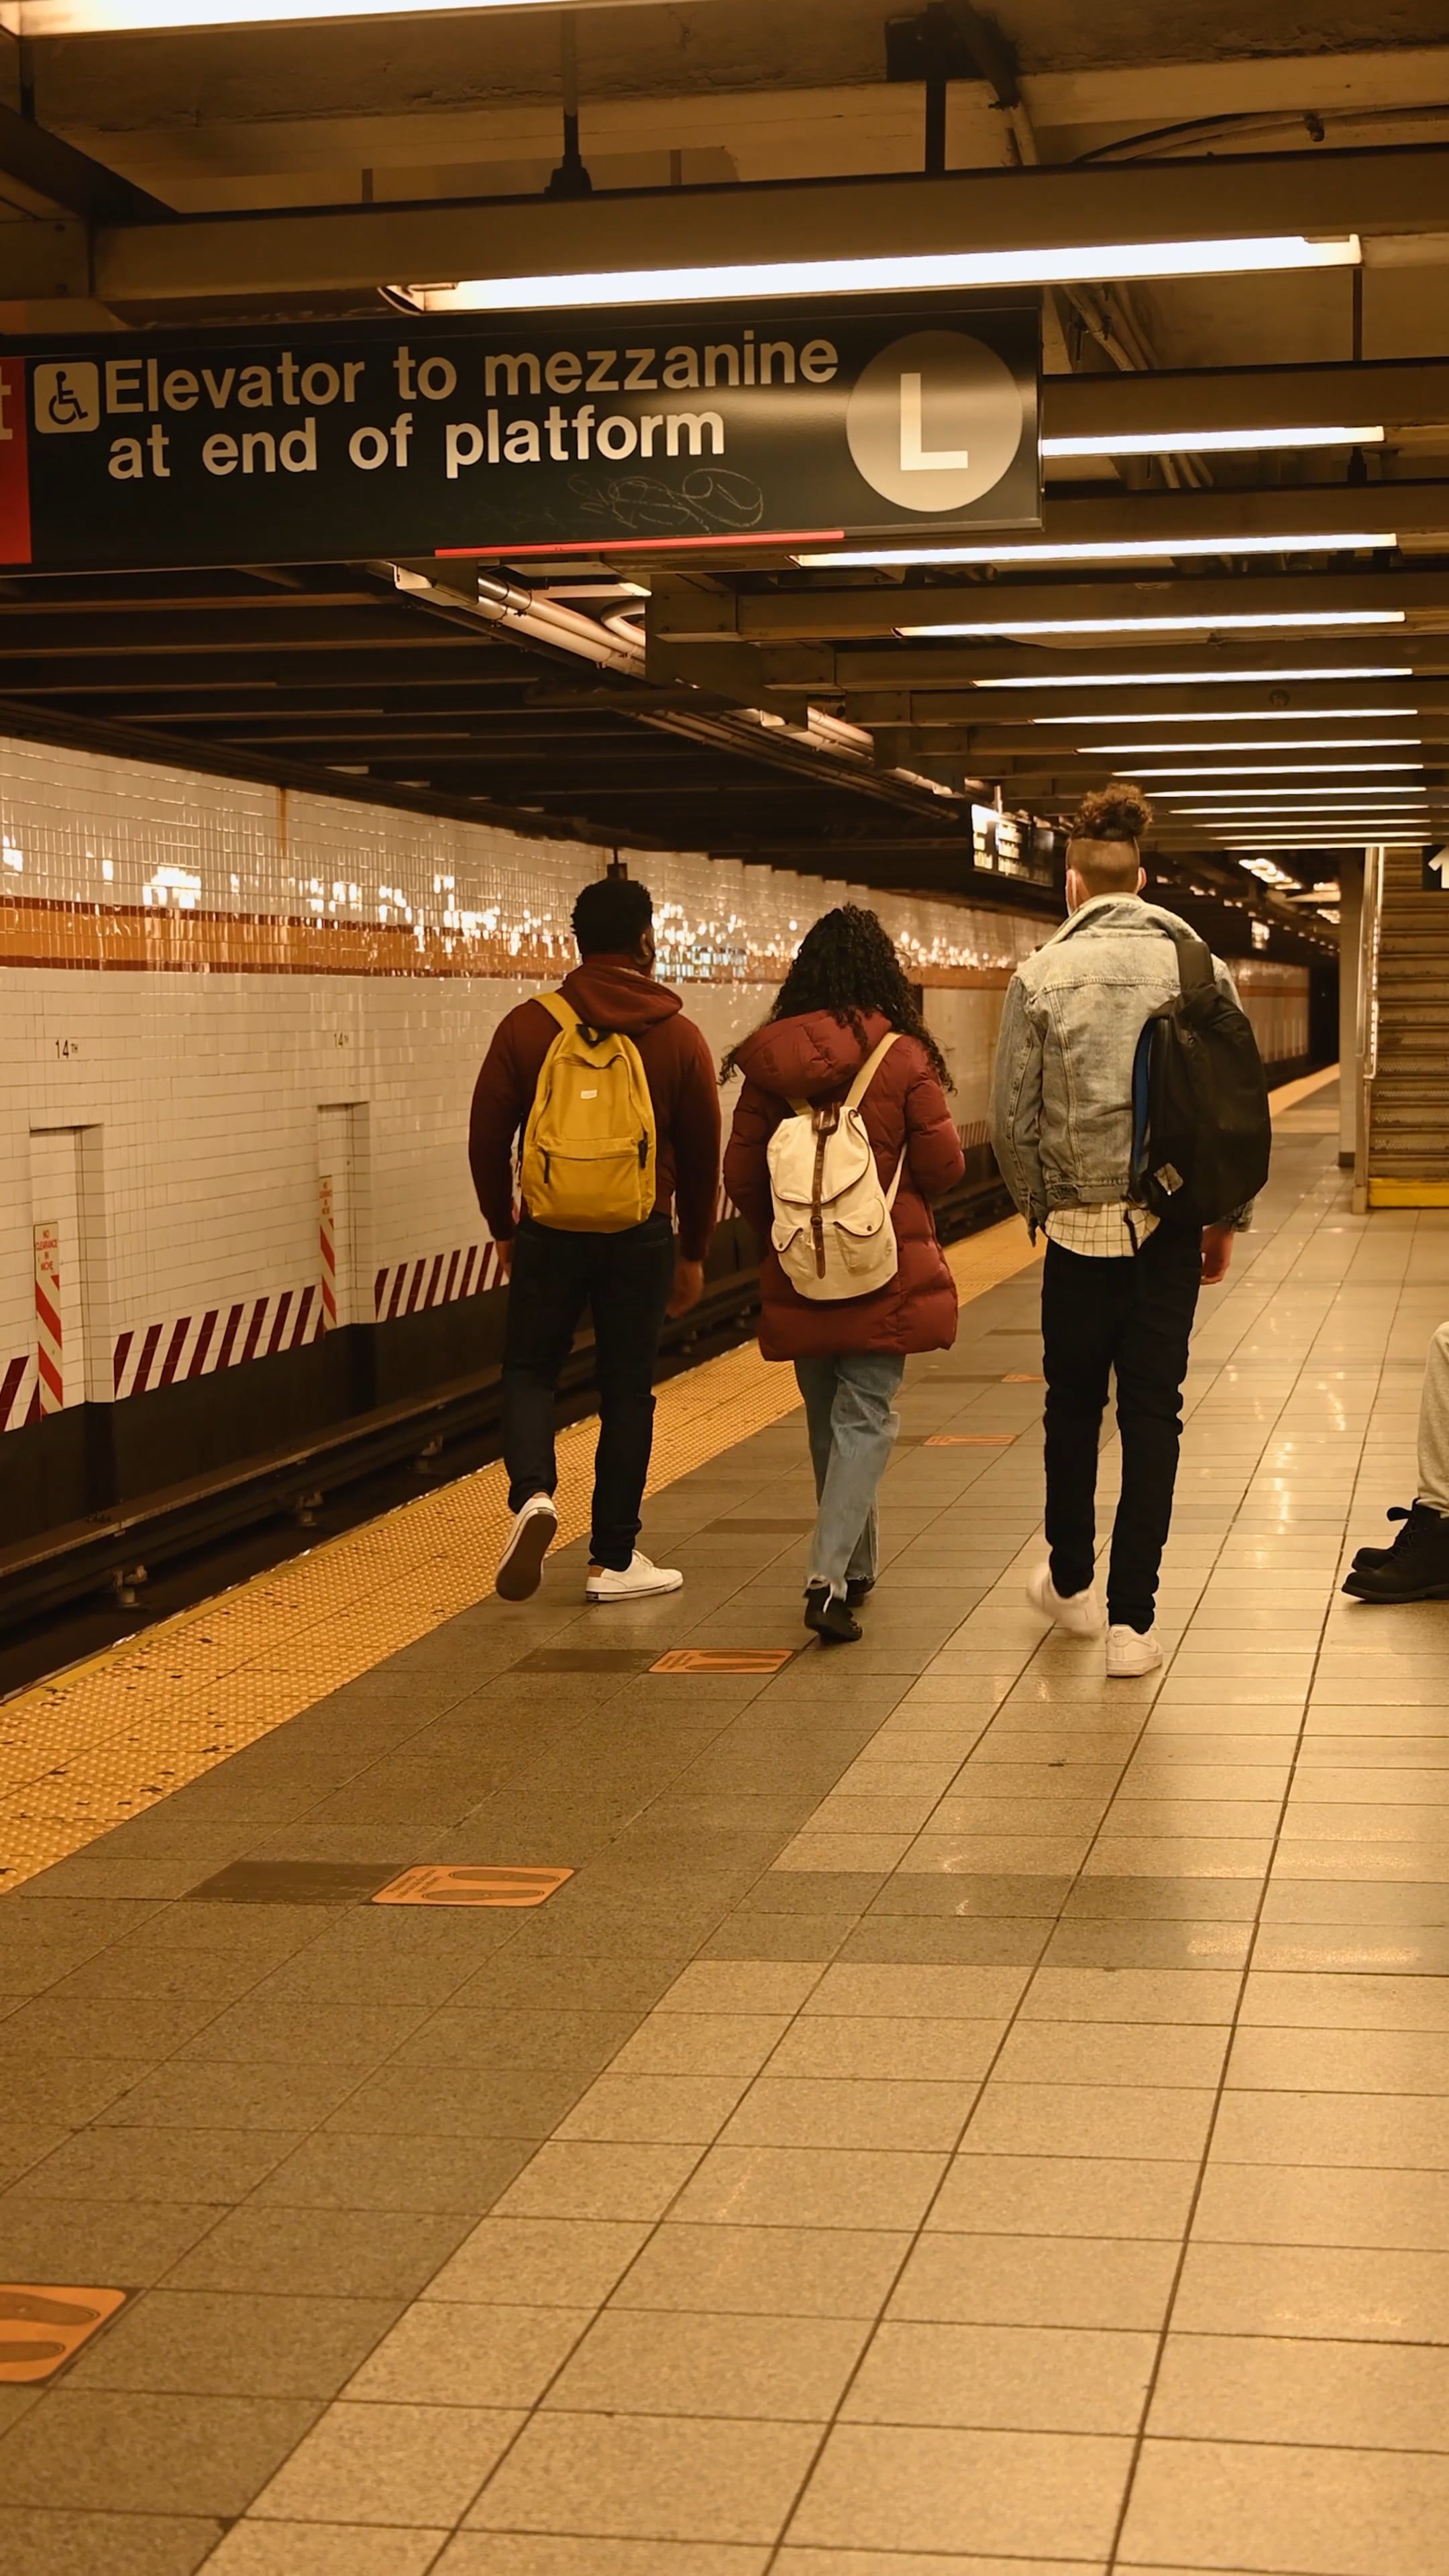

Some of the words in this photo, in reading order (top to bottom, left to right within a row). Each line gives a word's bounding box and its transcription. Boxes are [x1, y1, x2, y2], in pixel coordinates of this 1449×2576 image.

[105, 352, 366, 414] Elevator
[393, 345, 457, 400] to
[485, 330, 839, 397] mezzanine
[108, 424, 170, 480] at
[203, 417, 317, 476] end
[349, 413, 414, 470] of
[445, 405, 724, 479] platform
[900, 372, 969, 471] L
